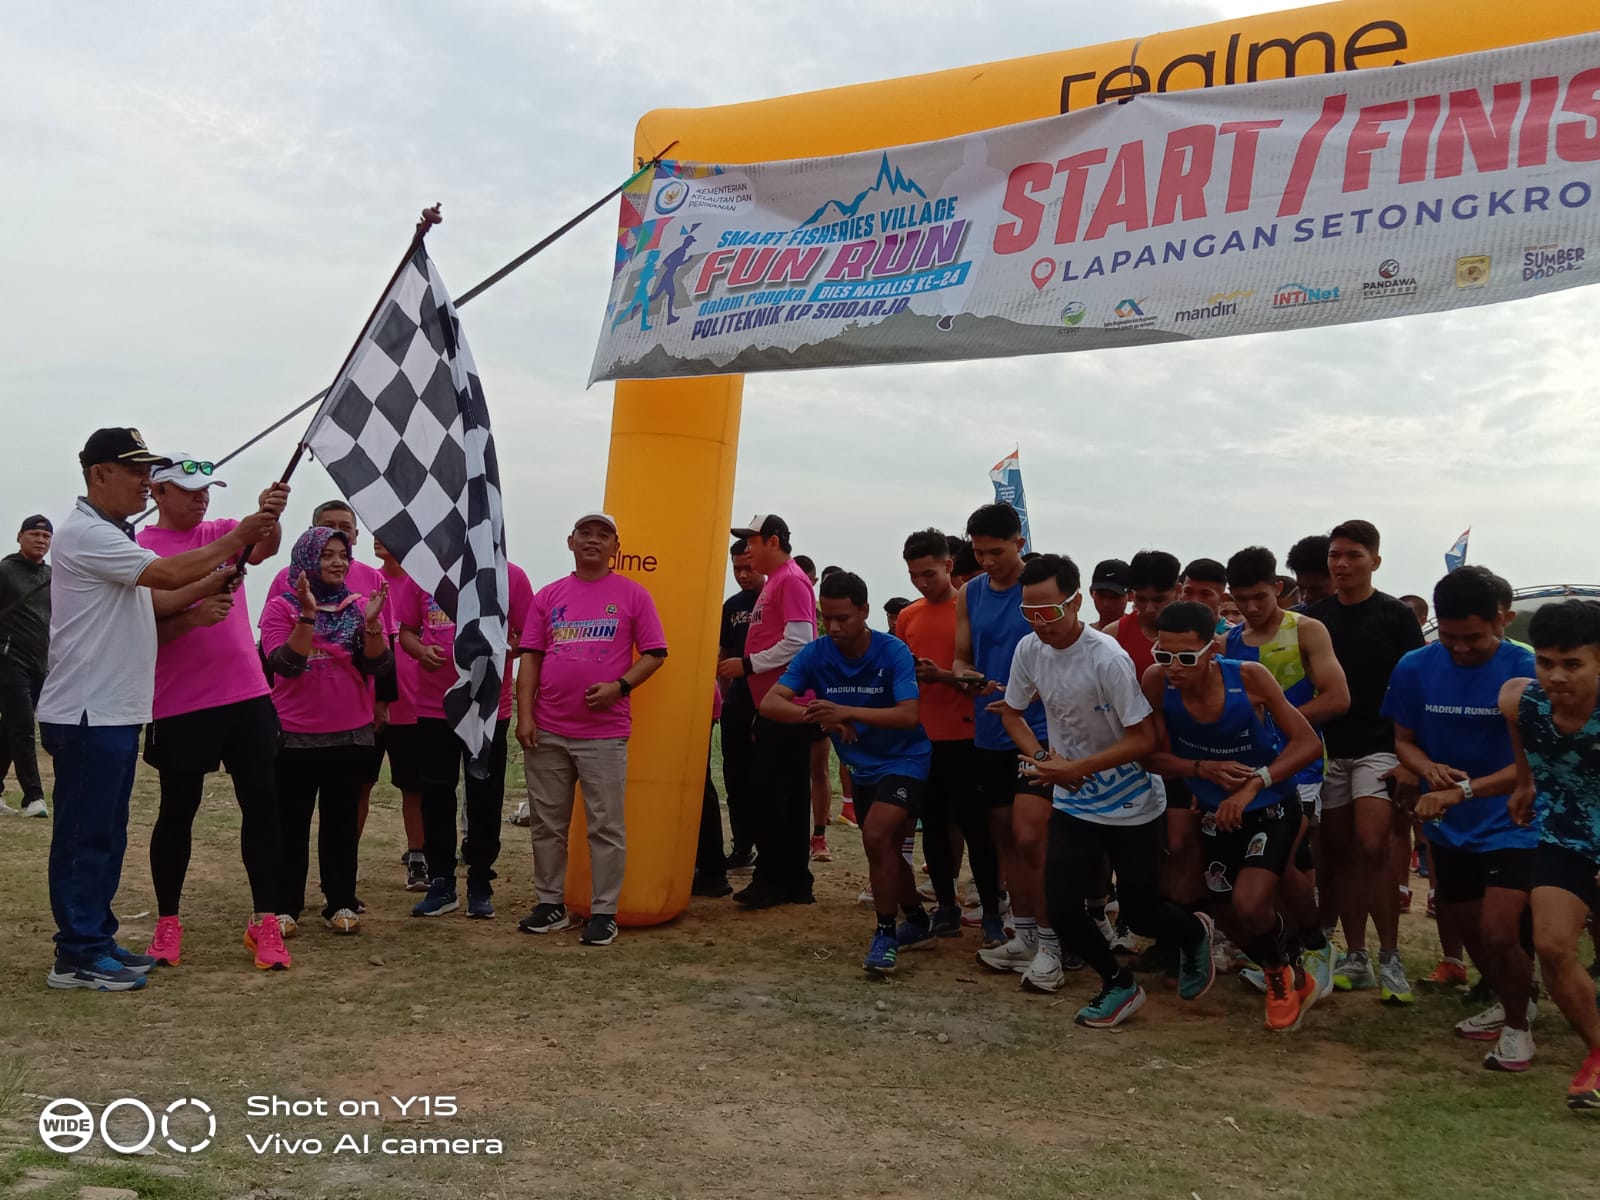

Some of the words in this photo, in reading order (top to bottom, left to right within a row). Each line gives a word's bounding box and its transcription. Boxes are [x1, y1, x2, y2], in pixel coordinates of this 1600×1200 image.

[1060, 20, 1408, 114] realme
[691, 194, 735, 203] KELAUTAN
[736, 193, 752, 203] DAN
[696, 183, 747, 195] KEMENTERIAN
[688, 201, 736, 211] PERIKANAN
[717, 230, 788, 249] SMART
[788, 213, 874, 246] FISHERIES
[879, 196, 959, 233] VILLAGE
[1062, 223, 1278, 282] LAPANGAN
[1294, 180, 1592, 243] SETONGKRO
[694, 245, 825, 295] FUN
[824, 217, 970, 282] RUN
[1523, 247, 1585, 268] SUMBER
[698, 294, 745, 317] dalam
[819, 284, 849, 299] DIES
[850, 277, 914, 297] NATALIS
[917, 268, 960, 290] KE-24
[1363, 278, 1417, 290] PANDAWA
[691, 304, 785, 341] POLITEKNIK
[783, 303, 814, 323] KP
[1174, 301, 1237, 323] mandiri
[581, 625, 617, 640] RUN
[826, 686, 856, 695] MADIUN
[1425, 703, 1464, 715] MADIUN
